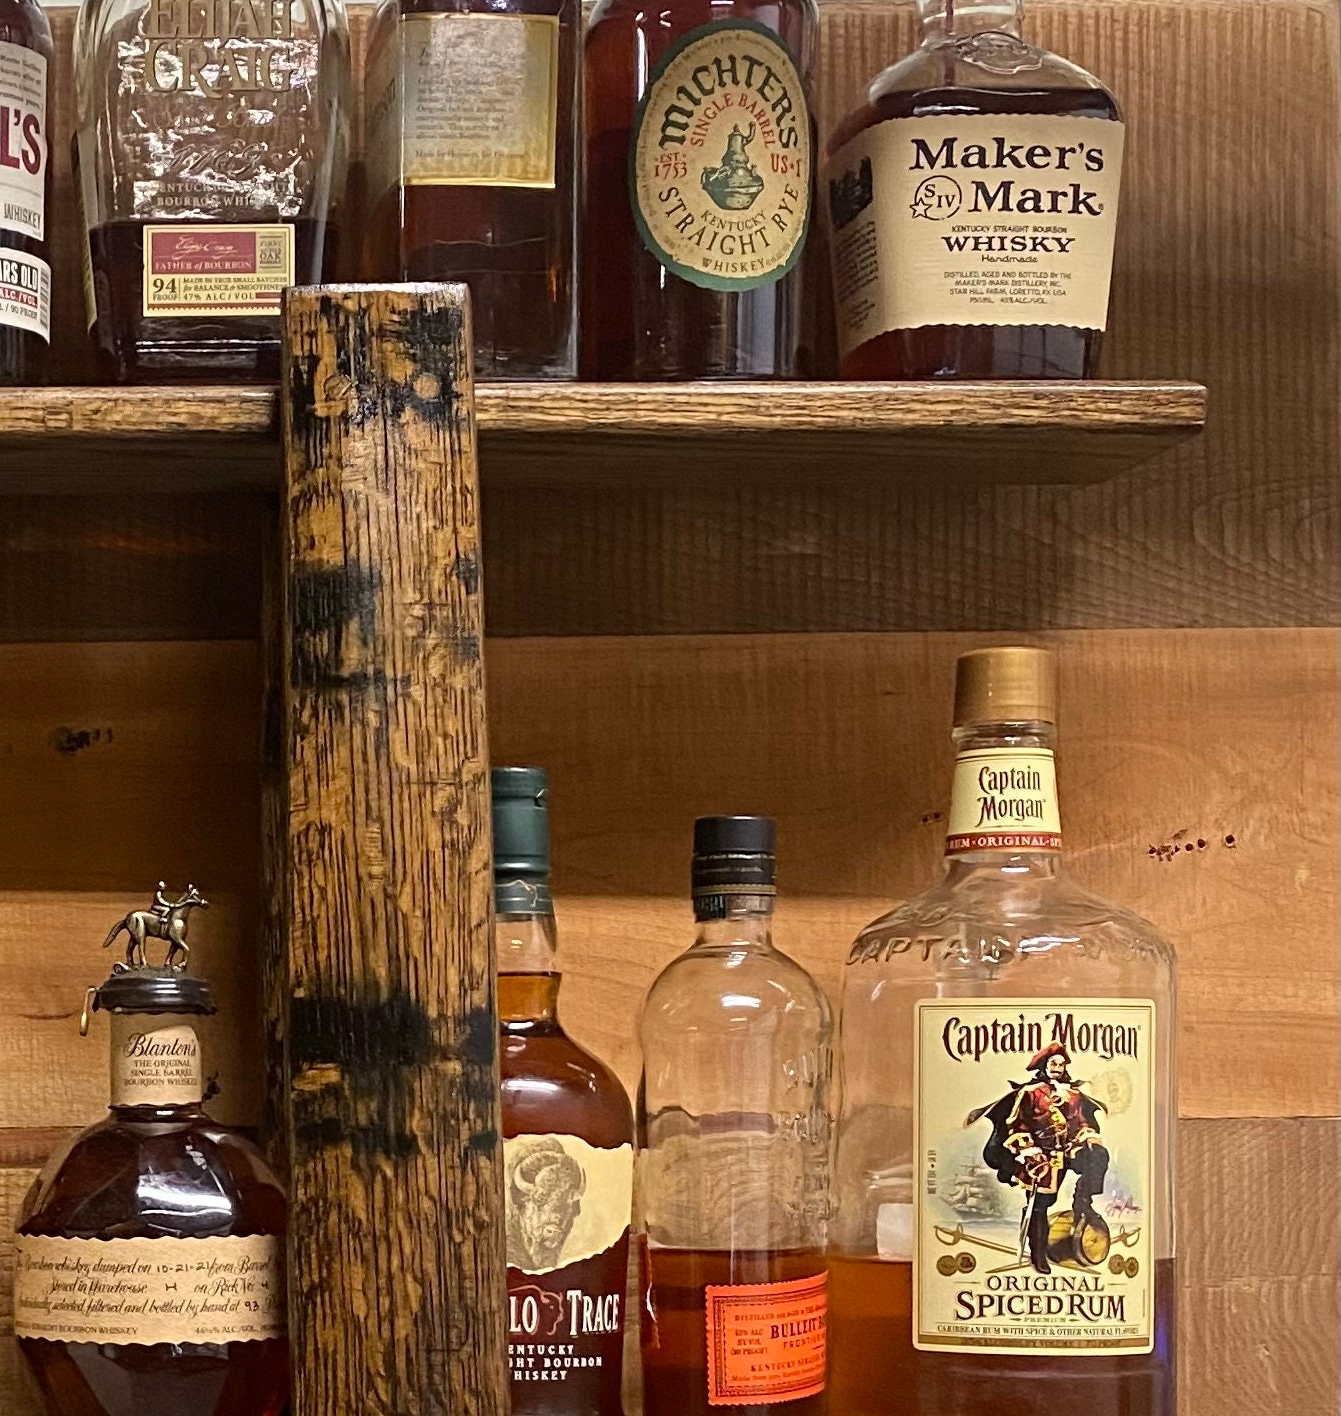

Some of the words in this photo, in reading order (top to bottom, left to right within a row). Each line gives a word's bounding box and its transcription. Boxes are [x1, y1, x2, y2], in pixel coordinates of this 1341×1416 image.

[144, 39, 293, 99] CRAIG
[659, 53, 798, 150] MICHTER'S
[690, 92, 733, 148] SINGLE
[738, 92, 778, 150] BARREL
[909, 137, 1104, 172] Maker's
[967, 180, 1101, 216] Mark
[4, 203, 42, 229] WHISKEY
[659, 186, 772, 256] STRAIGHT
[771, 182, 799, 233] RYE
[700, 209, 767, 232] KENTUCKY
[952, 225, 990, 233] KENTUCKY
[941, 236, 1076, 253] WHISKY
[155, 261, 192, 271] FATHER
[204, 261, 251, 270] BOURBON
[702, 256, 766, 274] WHISKEY
[982, 254, 1038, 263] Handmade
[20, 265, 38, 291] OLD
[152, 277, 177, 294] 94
[978, 765, 1041, 795] Captain
[975, 796, 1043, 828] Morgan
[123, 1032, 198, 1059] Blanton's
[941, 1013, 1042, 1063] Captain
[1045, 1013, 1139, 1060] Morgan
[129, 1068, 161, 1077] SINGLE
[134, 1059, 152, 1067] THE
[986, 1275, 1105, 1292] ORIGINAL
[566, 1289, 620, 1338] TRACE
[954, 1290, 1065, 1322] SPICED
[1068, 1293, 1127, 1322] RUM
[514, 1370, 568, 1381] HISKEY
[544, 1357, 602, 1368] BOURBON
